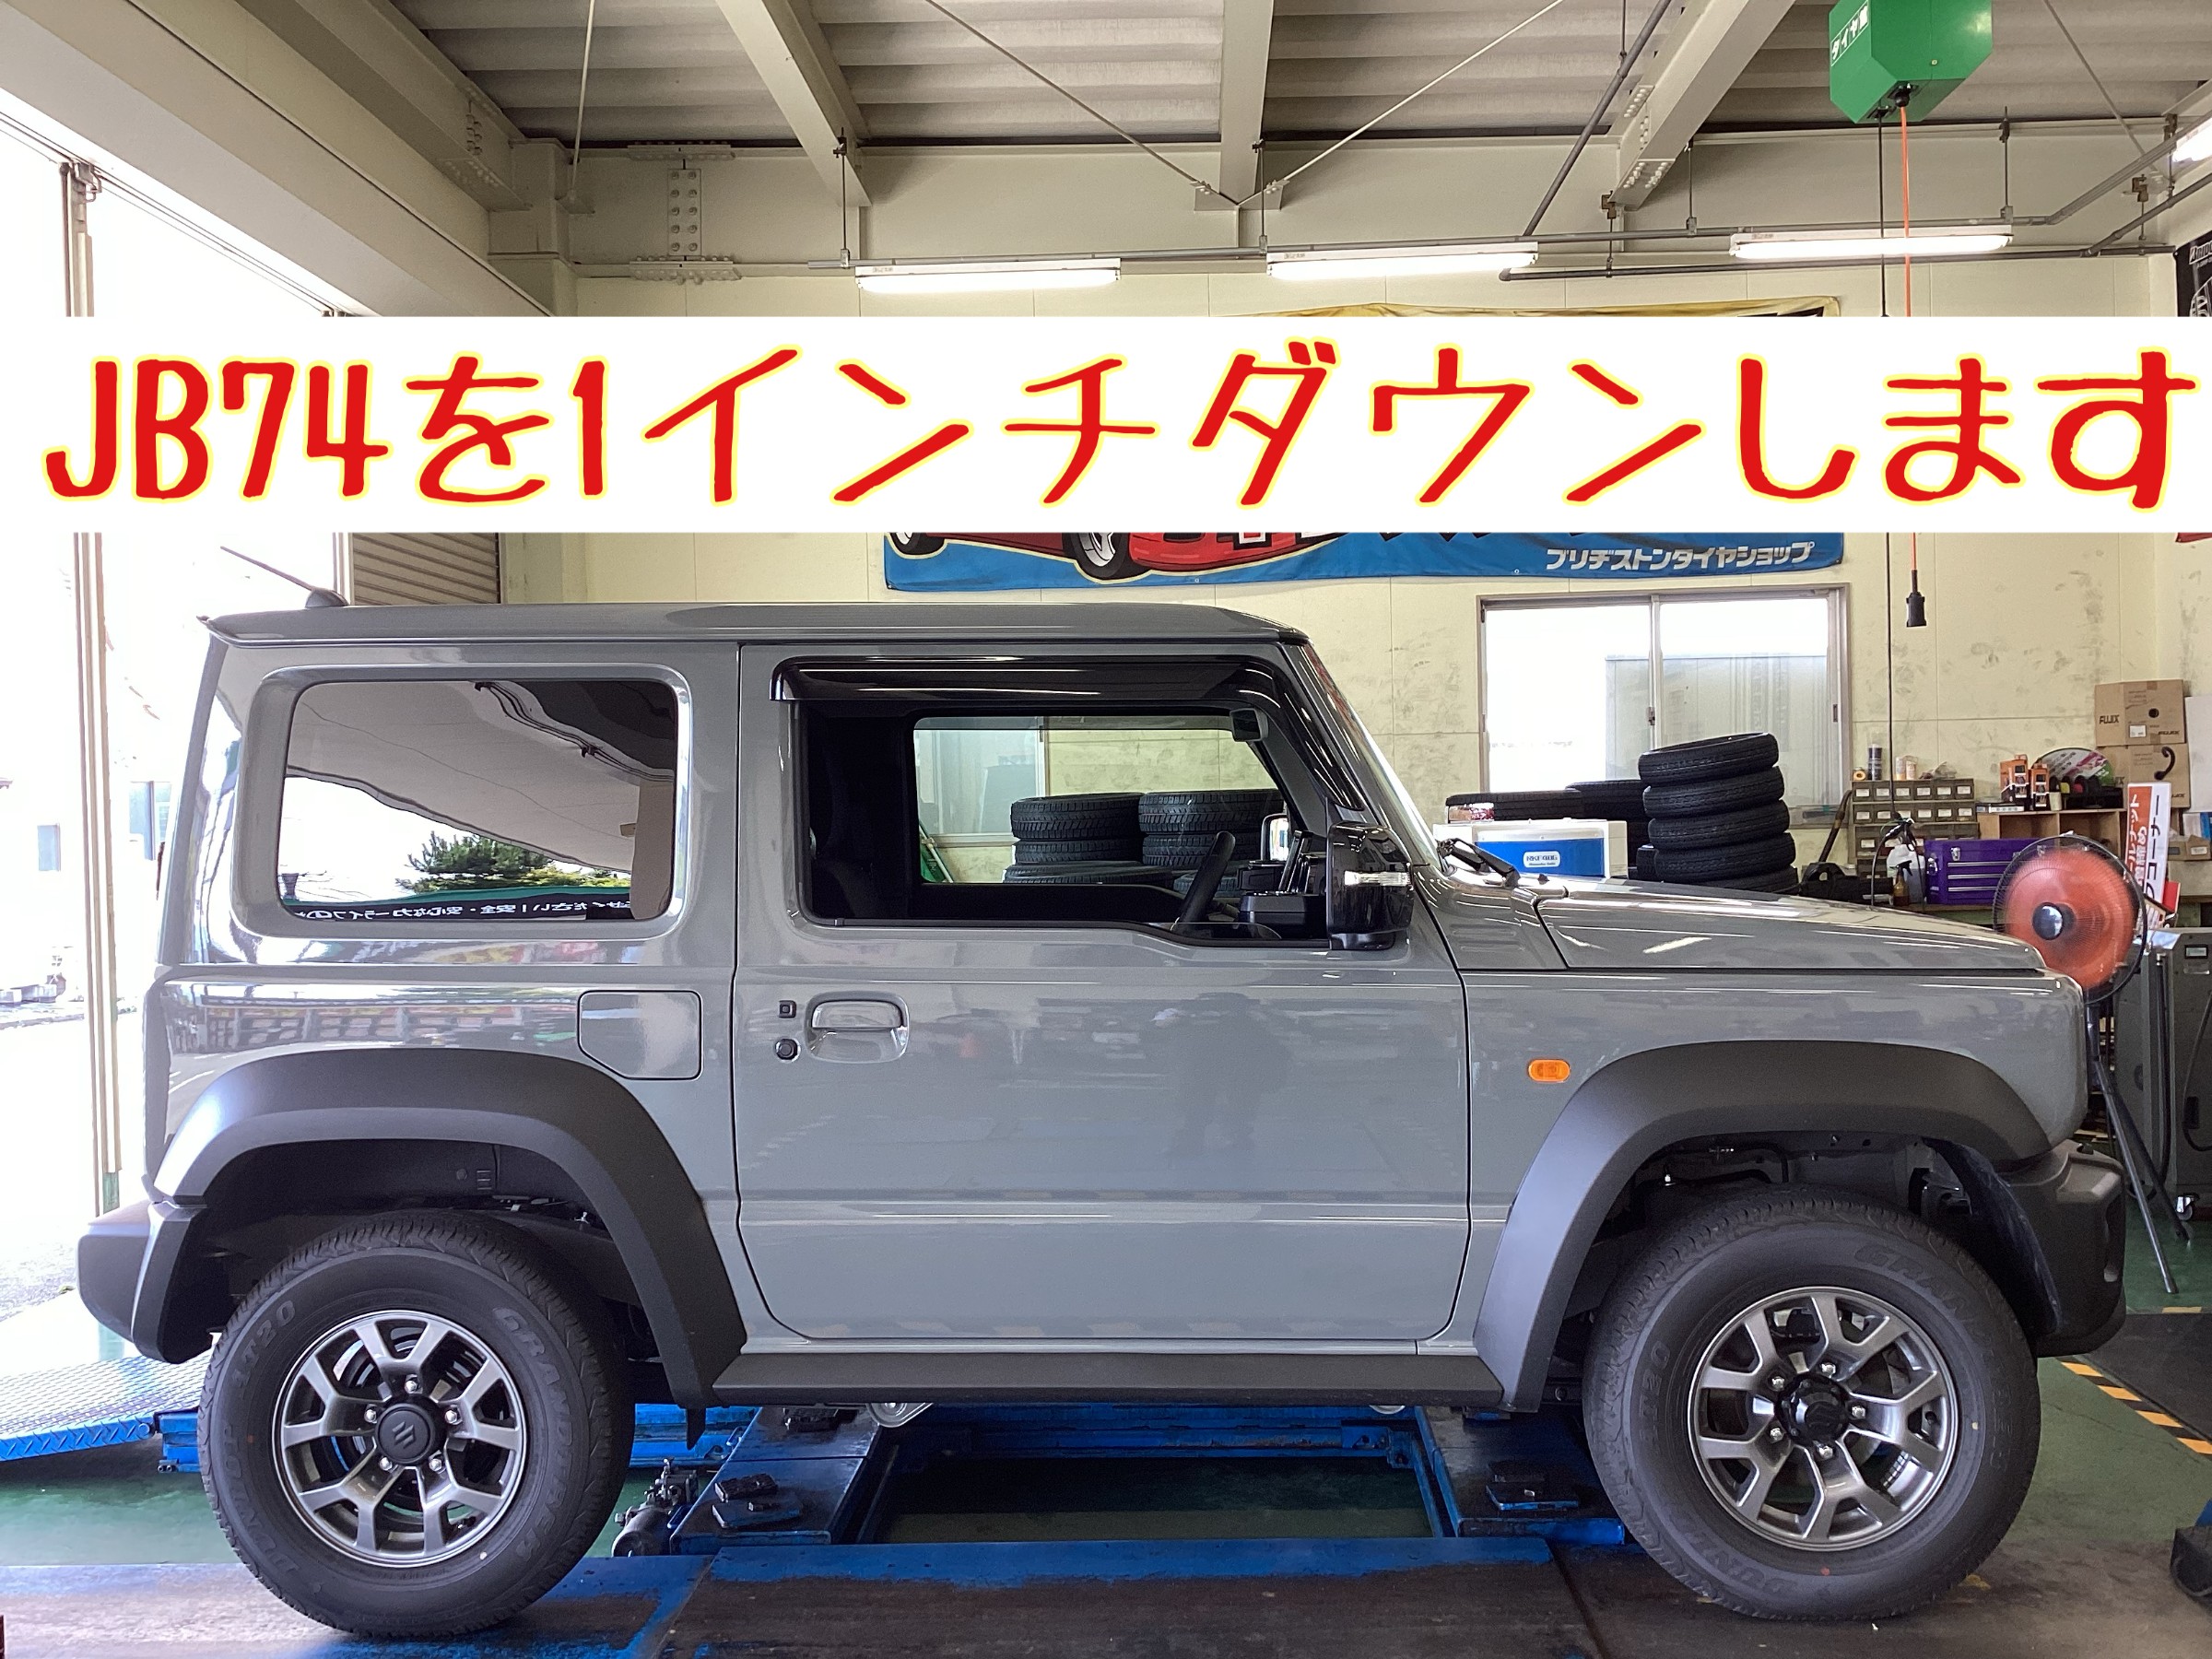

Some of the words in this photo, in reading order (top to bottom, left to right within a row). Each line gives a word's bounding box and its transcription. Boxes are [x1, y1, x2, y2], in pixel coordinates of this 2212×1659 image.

[1546, 541, 1815, 571] ブリヂストンタイヤショップ
